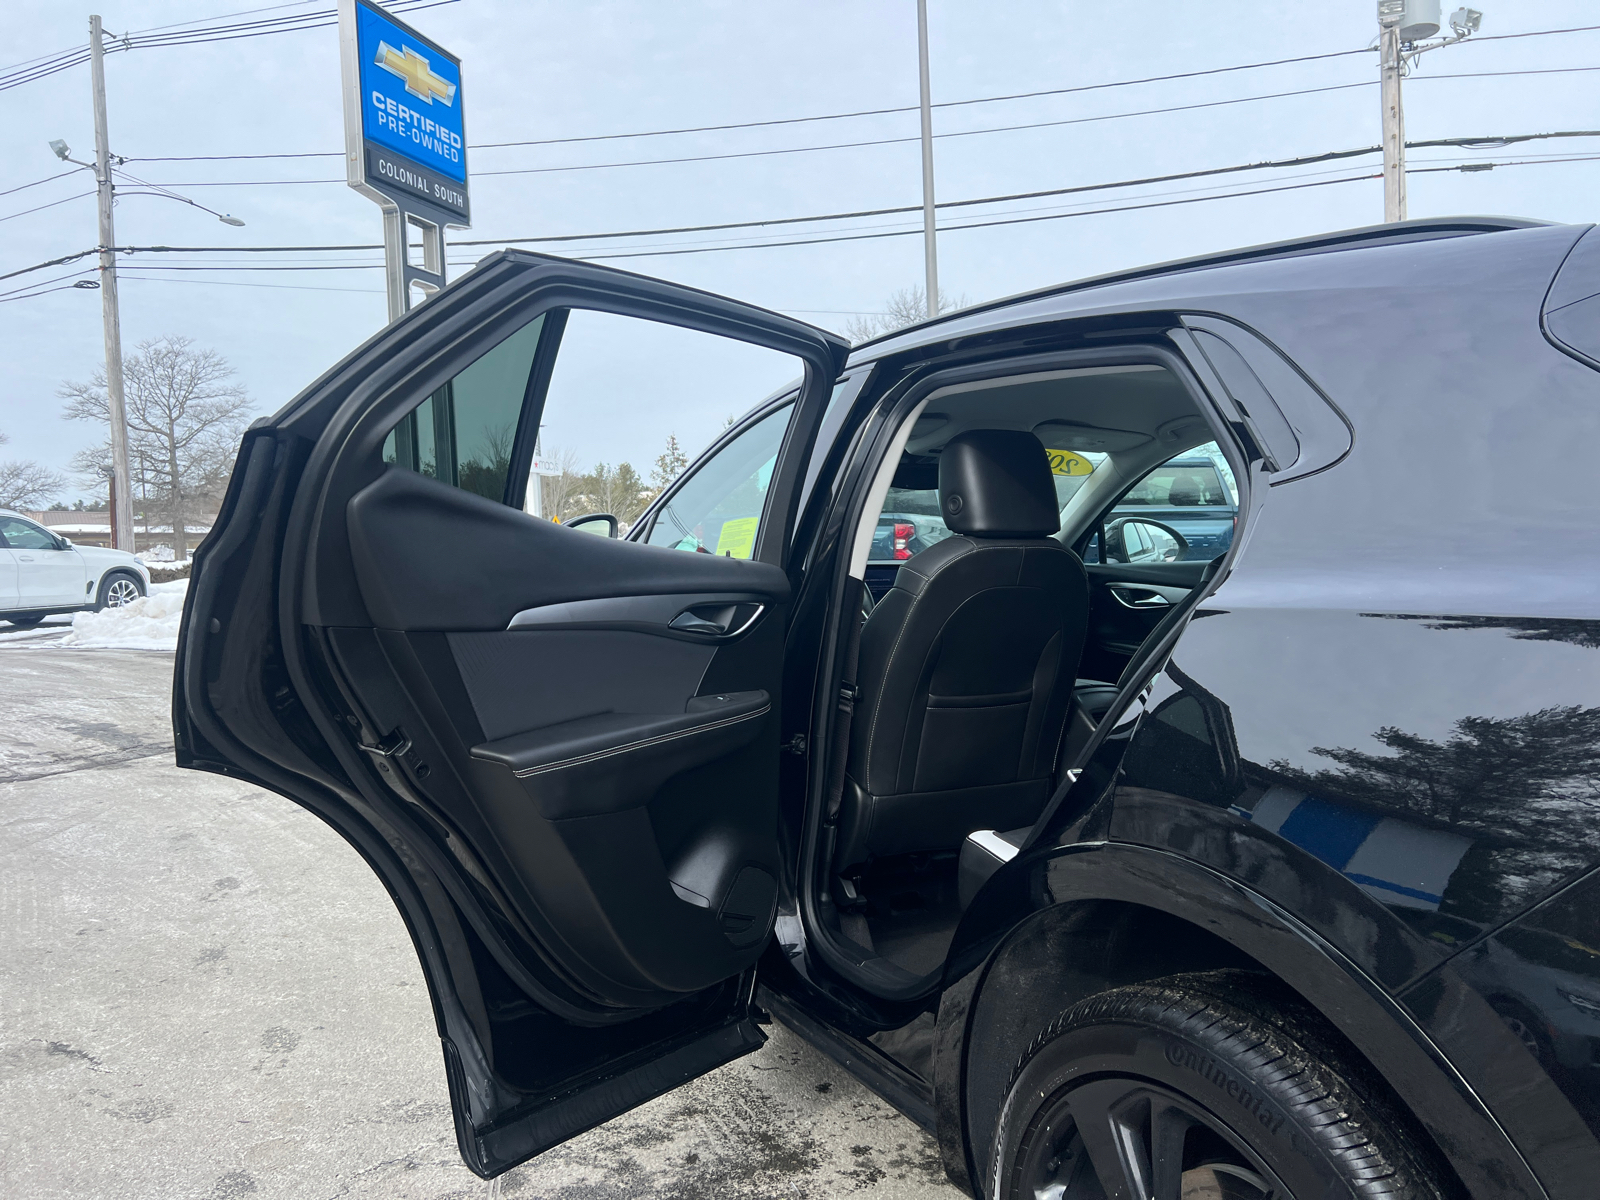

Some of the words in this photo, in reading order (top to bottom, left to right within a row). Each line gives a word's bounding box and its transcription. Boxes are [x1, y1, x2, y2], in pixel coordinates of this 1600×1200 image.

[372, 90, 461, 149] CERTIFIED
[378, 110, 459, 163] PRE-OWNED
[379, 159, 429, 194] COLONIAL
[434, 183, 463, 208] SOUTH
[1164, 1043, 1285, 1136] Continental
